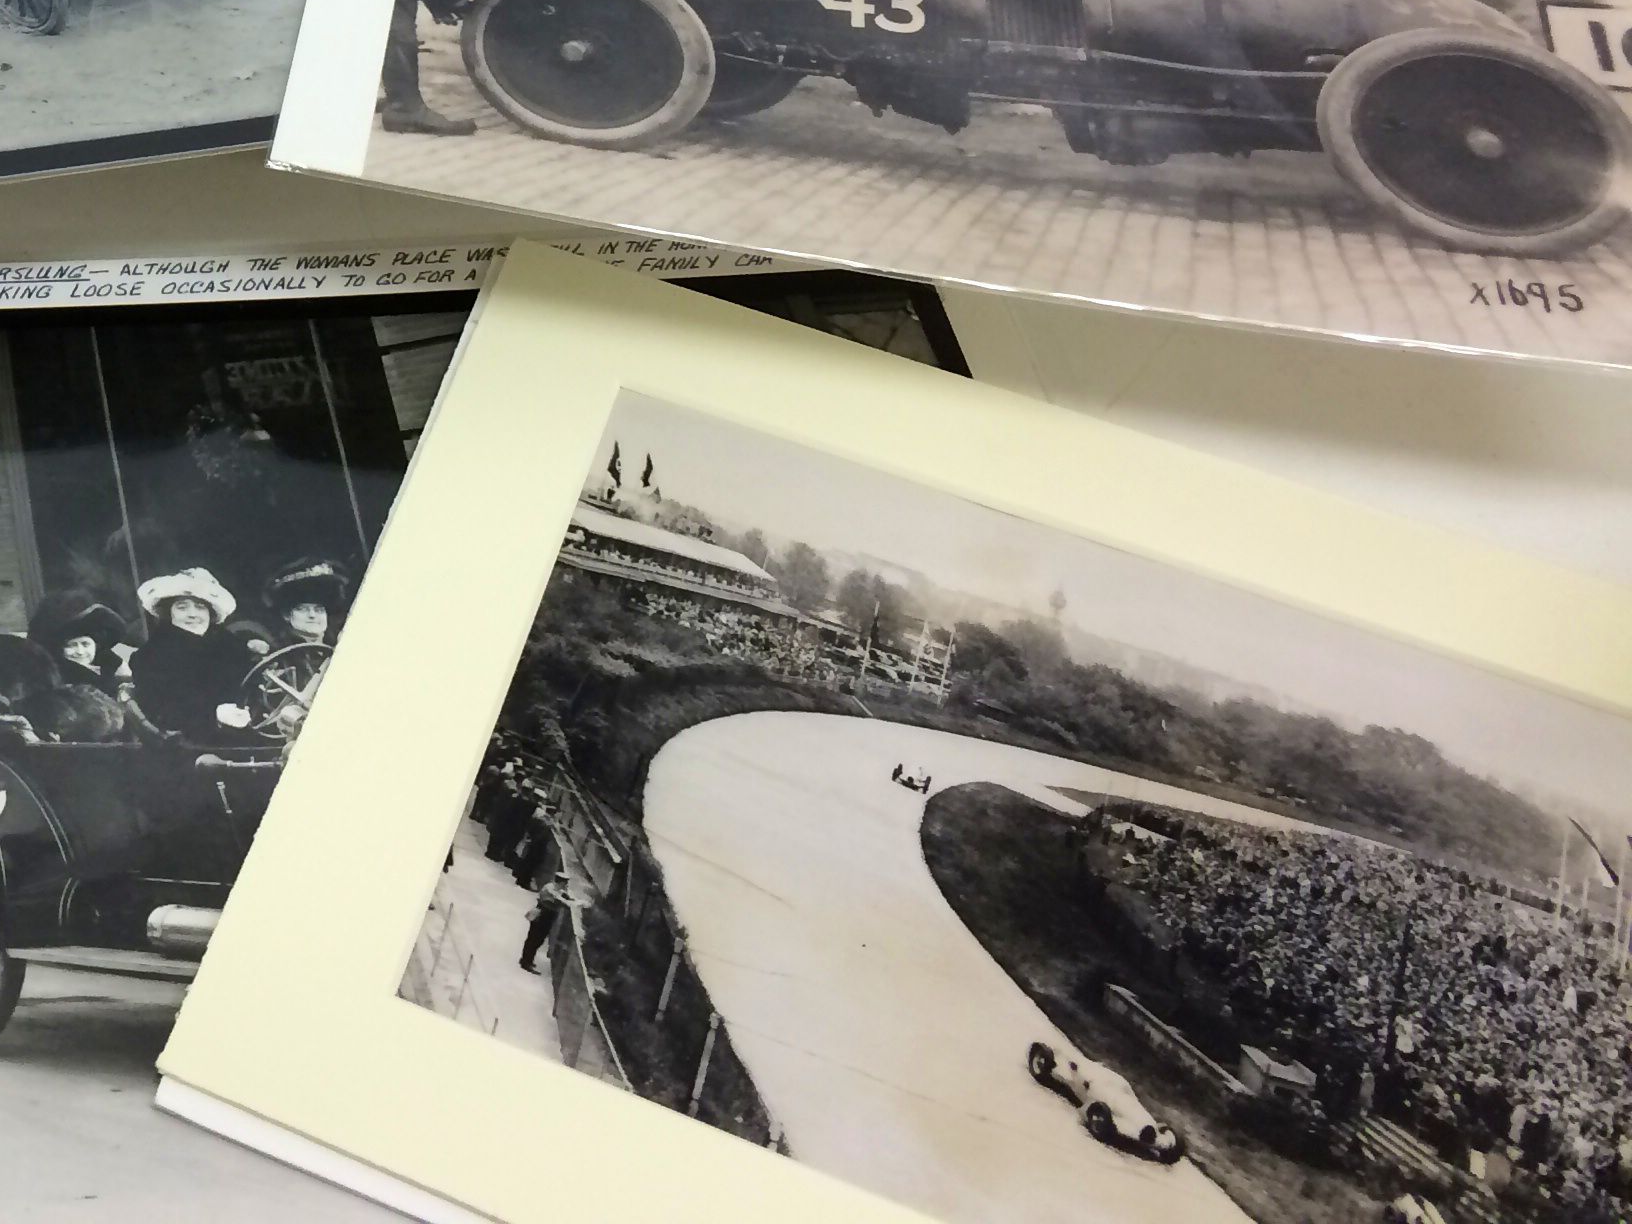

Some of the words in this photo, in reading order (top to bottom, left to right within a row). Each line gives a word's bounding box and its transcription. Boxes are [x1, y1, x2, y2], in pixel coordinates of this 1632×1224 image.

[70, 280, 145, 299] LOOSE
[161, 274, 326, 296] OCCASIONALLY
[344, 273, 366, 288] TO
[376, 271, 407, 286] GO
[415, 269, 456, 285] FOR
[464, 268, 477, 282] A
[636, 254, 720, 273] FAMILY
[120, 259, 231, 277] ALTHOUGH
[246, 256, 288, 272] THE
[392, 248, 457, 266] PLACE
[597, 240, 620, 255] IN
[625, 238, 662, 254] THE
